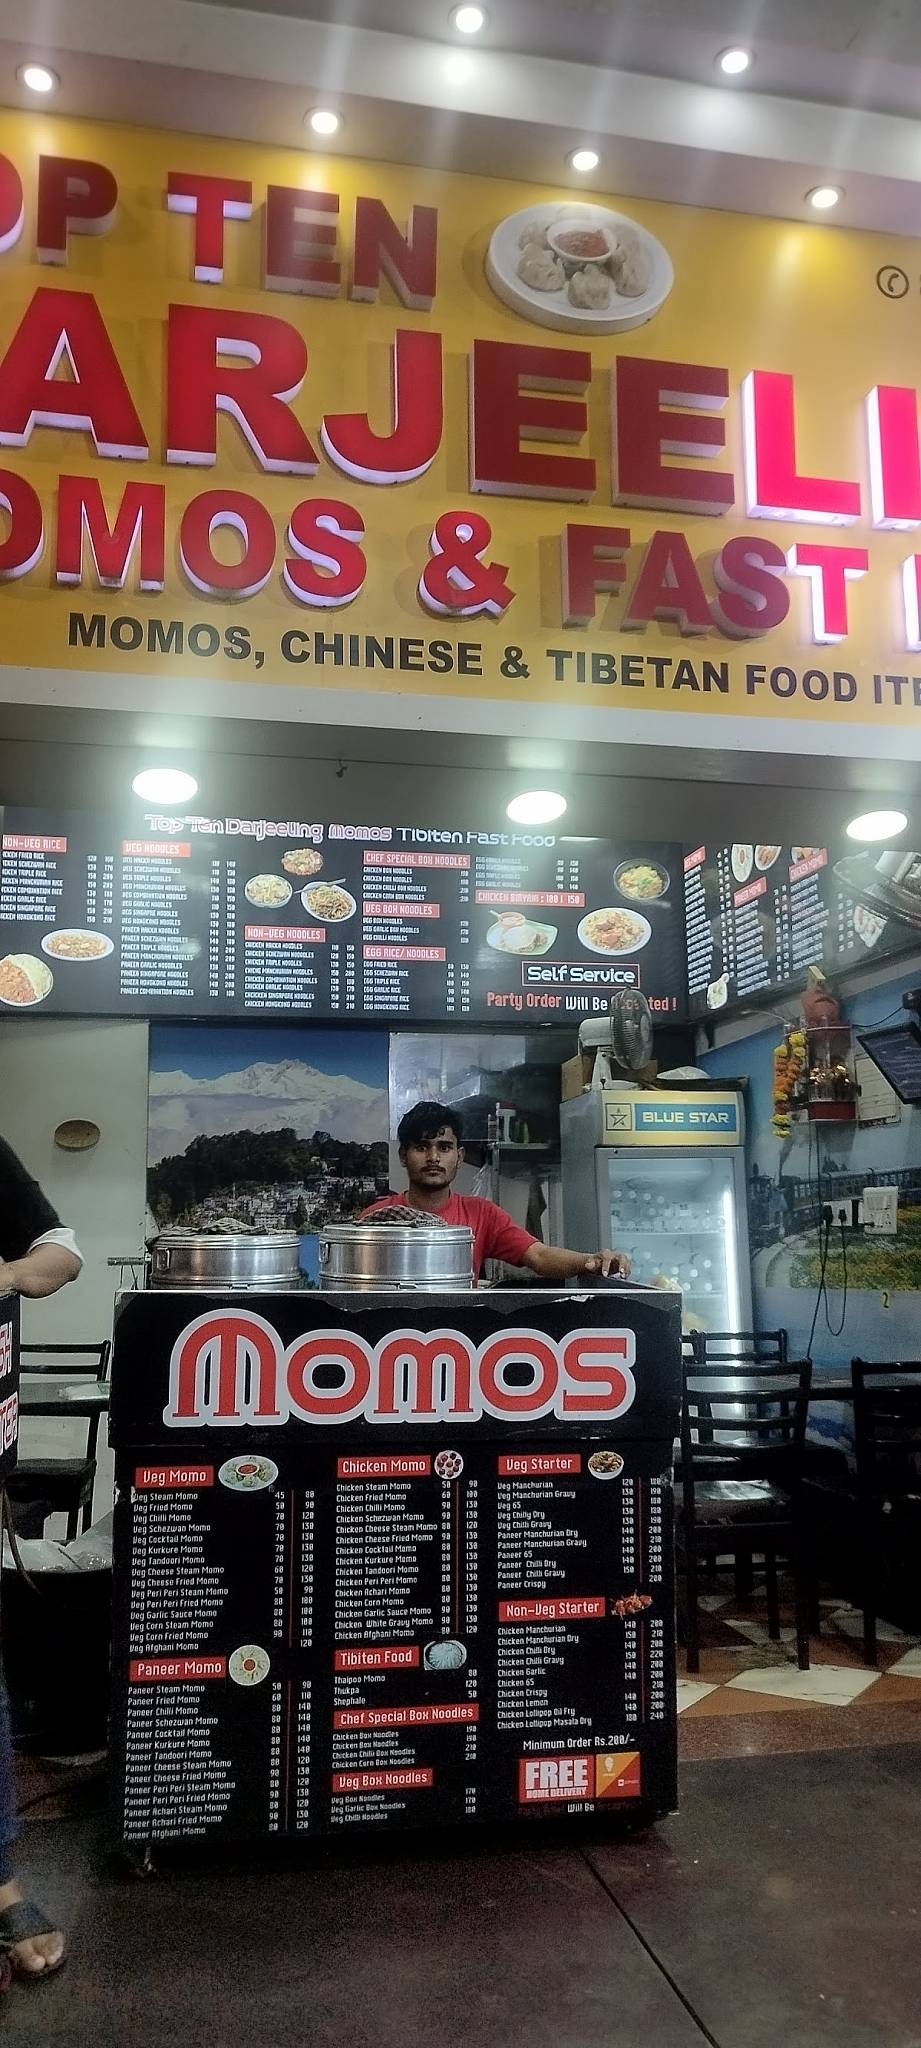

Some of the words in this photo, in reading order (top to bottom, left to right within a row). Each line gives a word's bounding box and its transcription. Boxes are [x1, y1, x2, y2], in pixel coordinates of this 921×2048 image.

[0, 152, 118, 265] P
[167, 171, 438, 311] TEN
[418, 511, 517, 618] &
[561, 523, 868, 645] FAST
[67, 612, 265, 669] MOMOS,
[281, 630, 483, 675] CHINESE
[500, 645, 530, 679] &
[546, 648, 729, 693] TIBETAN
[746, 664, 857, 702] FOOD
[144, 814, 184, 834] Top
[225, 818, 323, 843] Darjeeling
[466, 832, 508, 846] Fast
[512, 834, 555, 847] Food
[3, 837, 40, 848] NON-VEG
[43, 839, 61, 849] RICE
[125, 842, 142, 853] VEG
[145, 843, 179, 855] NOODLES
[367, 853, 384, 862] CHEF
[387, 854, 417, 864] SPECIAL
[419, 855, 433, 864] BOX
[435, 856, 467, 866] NOODLES
[478, 893, 508, 902] CHICKEN
[365, 904, 380, 913] VEG
[383, 905, 398, 914] BOX
[400, 905, 433, 914] NOODLES
[248, 928, 284, 937] NON-VEG
[287, 929, 320, 939] NOODLES
[366, 948, 381, 957] EGG
[407, 949, 439, 958] NOODLES
[527, 964, 567, 983] Self
[570, 965, 635, 983] Service
[487, 992, 523, 1011] Party
[526, 992, 561, 1008] Order
[565, 995, 589, 1011] Will
[592, 997, 608, 1011] Be
[642, 1112, 684, 1123] BLUE
[689, 1112, 729, 1123] STAR
[164, 1307, 637, 1428] Momos
[342, 1461, 387, 1473] Chicken
[391, 1460, 426, 1471] Momo
[506, 1459, 528, 1472] Veg
[532, 1458, 572, 1470] Starter
[143, 1470, 165, 1485] Veg
[169, 1469, 206, 1483] Momo
[337, 1483, 363, 1491] Chicken
[365, 1483, 388, 1491] Steam
[498, 1482, 511, 1490] Veg
[513, 1481, 553, 1489] Manchurian
[150, 1492, 173, 1501] Steam
[175, 1492, 198, 1500] Momo
[275, 1491, 285, 1499] 45
[133, 1504, 148, 1513] Veg
[150, 1503, 169, 1511] Fried
[170, 1503, 193, 1511] Momo
[336, 1504, 363, 1512] Chicken
[384, 1503, 405, 1511] Momo
[498, 1502, 511, 1510] Veg
[133, 1514, 147, 1523] Veg
[149, 1514, 167, 1522] Chilli
[169, 1513, 191, 1521] Momo
[498, 1551, 521, 1559] Paneer
[498, 1581, 521, 1589] Paneer
[524, 1580, 546, 1589] Crispy
[507, 1604, 555, 1618] Non-Veg
[559, 1601, 599, 1614] Starter
[341, 1652, 381, 1665] Tibiten
[384, 1650, 412, 1662] Food
[137, 1663, 180, 1676] Paneer
[184, 1661, 222, 1674] Momo
[498, 1679, 524, 1687] Chicken
[128, 1686, 154, 1695] Paneer
[157, 1686, 180, 1694] Steam
[334, 1687, 360, 1696] Thukpa
[498, 1690, 524, 1698] Chicken
[526, 1689, 547, 1698] Crispy
[128, 1697, 153, 1706] Paneer
[156, 1696, 175, 1705] Fried
[340, 1712, 365, 1725] Chef
[369, 1711, 406, 1723] Special
[409, 1710, 429, 1721] Box
[432, 1707, 473, 1719] Noodles
[523, 1740, 564, 1750] Minimum
[567, 1737, 592, 1747] Order
[339, 1776, 359, 1789] Veg
[363, 1775, 382, 1786] Box
[386, 1772, 427, 1784] Noodles
[526, 1760, 588, 1790] FREE
[551, 1787, 587, 1797] DELIVERY
[568, 1803, 582, 1812] Will
